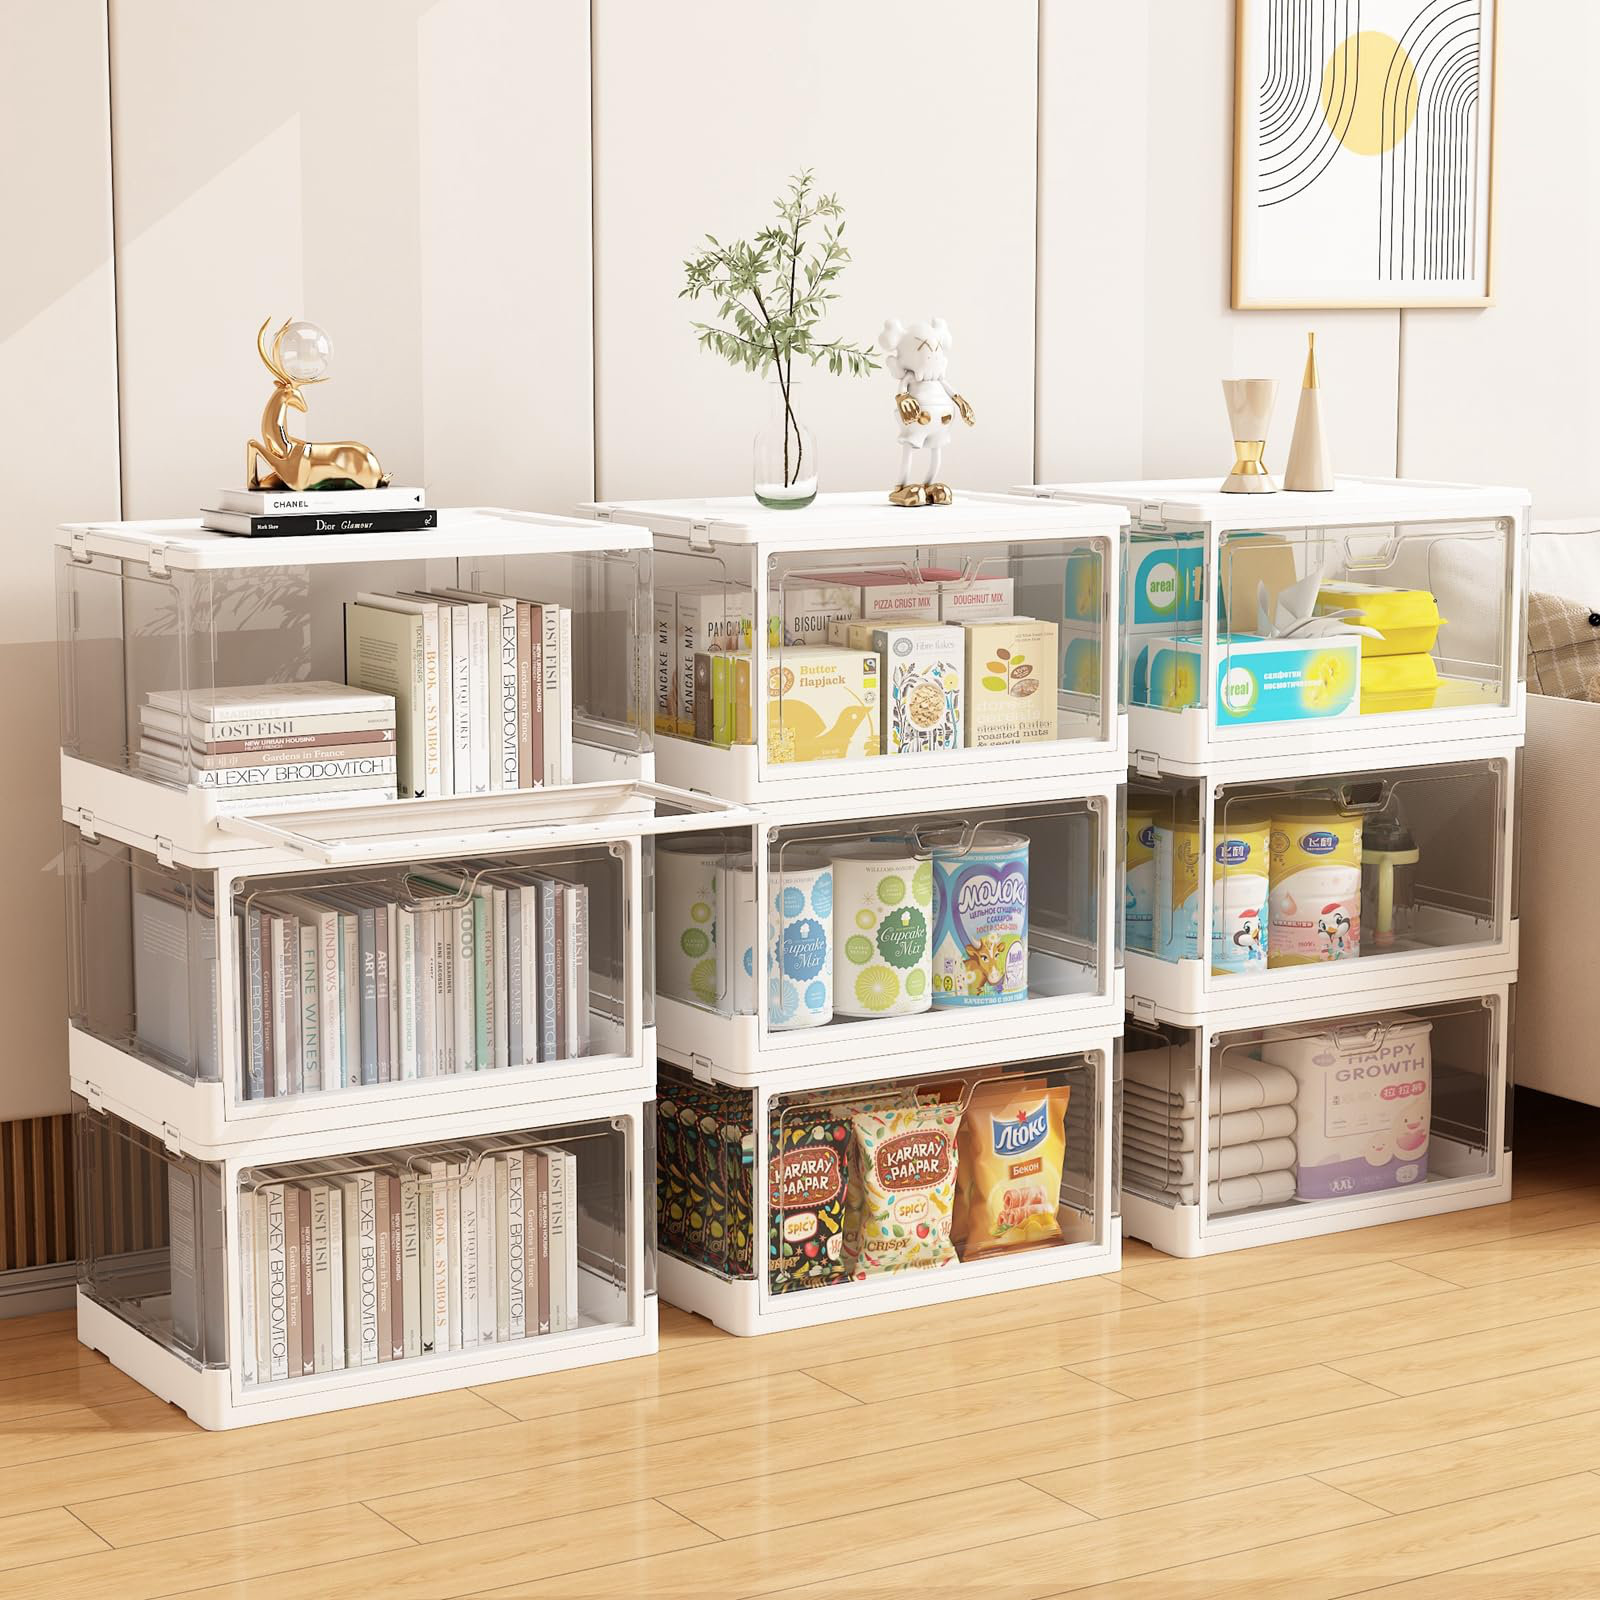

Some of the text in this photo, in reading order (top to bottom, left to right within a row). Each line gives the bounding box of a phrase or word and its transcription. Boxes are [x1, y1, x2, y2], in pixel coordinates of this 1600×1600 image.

[273, 501, 309, 509] CHANEL
[315, 519, 374, 531] Dior Glamour
[953, 593, 1005, 606] DOUGHNUT MIX
[1150, 578, 1175, 593] areal
[873, 597, 932, 610] PIZZA CRUST MIX
[544, 610, 559, 691] LOST FISH
[659, 620, 669, 709] PANCAKE MIX
[426, 650, 437, 690] BOOK
[684, 625, 694, 714] PANCAKE MIX
[799, 664, 838, 675] Butter
[799, 675, 847, 688] flapjack
[502, 604, 517, 783] ALEXEY BRODOVITCH
[520, 661, 529, 744] Gardens in France
[210, 720, 295, 740] LOST FISH
[244, 740, 261, 748] NEW
[427, 705, 439, 775] SYMBOLS
[1022, 729, 1049, 737] nuts
[262, 749, 346, 763] Gardens in France
[203, 758, 384, 787] ALEXEY BRODOVITCH
[461, 908, 474, 960] 1000
[575, 889, 585, 967] LOST FISH
[881, 926, 926, 945] Cupcake
[283, 919, 294, 999] LOST FISH
[326, 917, 337, 993] WINDOWS
[783, 937, 825, 957] Cupcake
[793, 953, 821, 969] Mix
[895, 941, 922, 957] Mix
[365, 951, 375, 980] ART
[378, 950, 388, 978] ART
[543, 885, 557, 1056] ALEXEY BRODOVITCH
[263, 970, 271, 1007] Gardens
[304, 949, 318, 1072] FINE WINES
[1336, 1057, 1425, 1082] GROWTH
[886, 1141, 943, 1167] KARARAY
[890, 1159, 940, 1181] PAAPAR
[1012, 1162, 1040, 1176] Бекон
[551, 1157, 564, 1236] LOST FISH
[898, 1202, 927, 1217] SPICY
[314, 1192, 328, 1273] LOST FISH
[405, 1223, 418, 1259] FISH
[508, 1156, 524, 1327] ALEXEY BRODOVITCH
[786, 1219, 816, 1235] SPICY
[360, 1177, 377, 1352] ALEXEY BRODOVITCH
[527, 1209, 537, 1288] Gardens in France
[269, 1191, 287, 1367] ALEXEY BRODOVITCH
[379, 1231, 390, 1313] Gardens in France
[434, 1207, 447, 1328] BOOK SYMBOLS
[289, 1245, 300, 1328] Gardens in France
